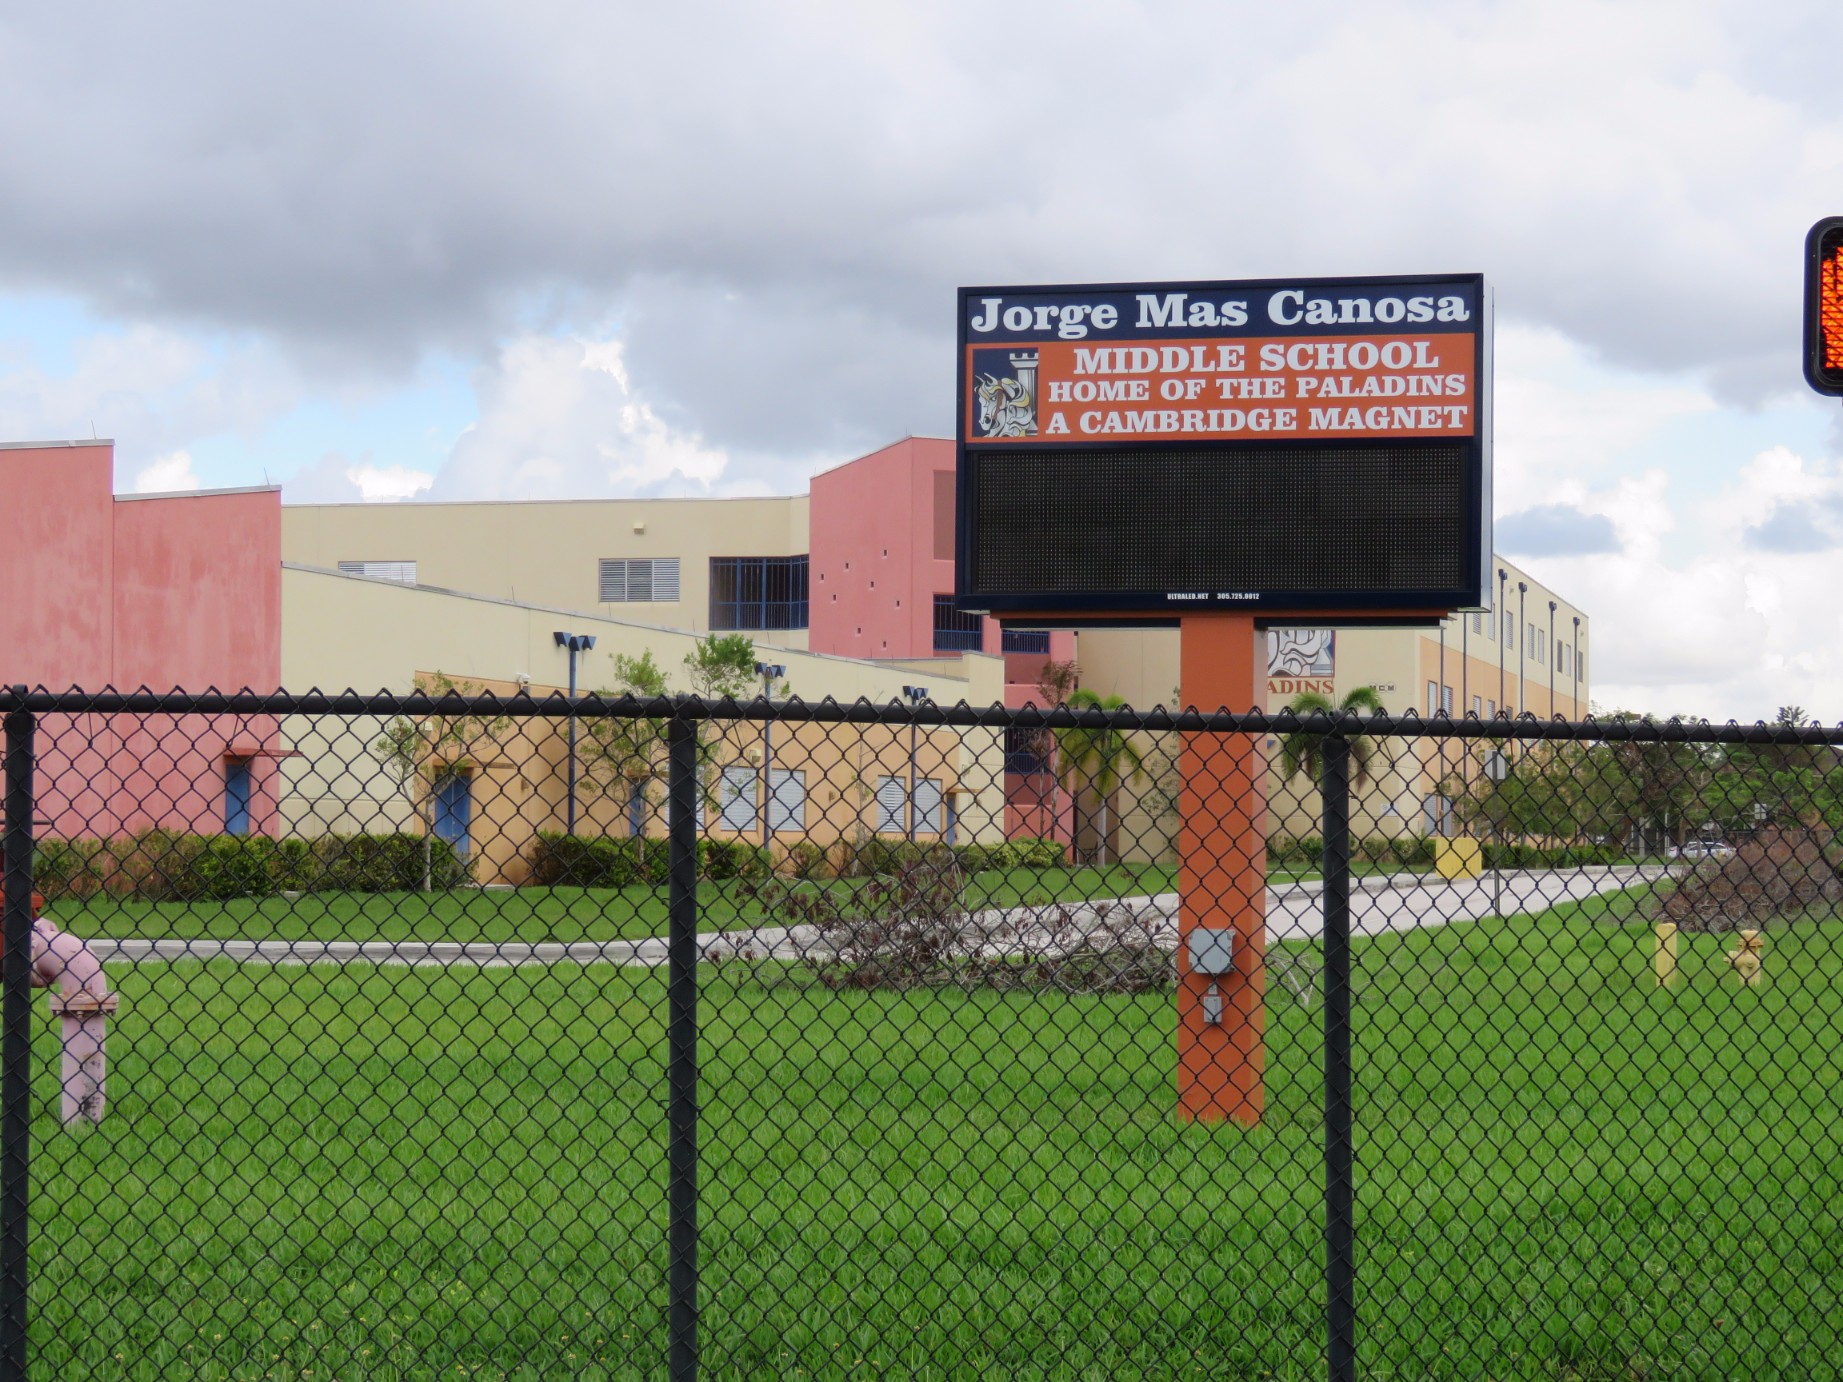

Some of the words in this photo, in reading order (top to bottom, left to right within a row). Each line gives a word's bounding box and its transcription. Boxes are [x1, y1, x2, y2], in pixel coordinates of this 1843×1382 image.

[971, 298, 1118, 339] Jorge
[1135, 294, 1248, 327] Mas
[1267, 290, 1470, 326] Canosa
[1073, 345, 1245, 375] MIDDLE
[1260, 341, 1439, 371] SCHOOL
[1048, 380, 1150, 402] HOME
[1160, 379, 1206, 400] OF
[1216, 377, 1286, 399] THE
[1296, 374, 1466, 398] PALADINS
[1045, 412, 1071, 434] A
[1079, 407, 1297, 434] CAMBRIDGE
[1308, 405, 1468, 431] MAGNET
[1267, 680, 1334, 694] ADINS
